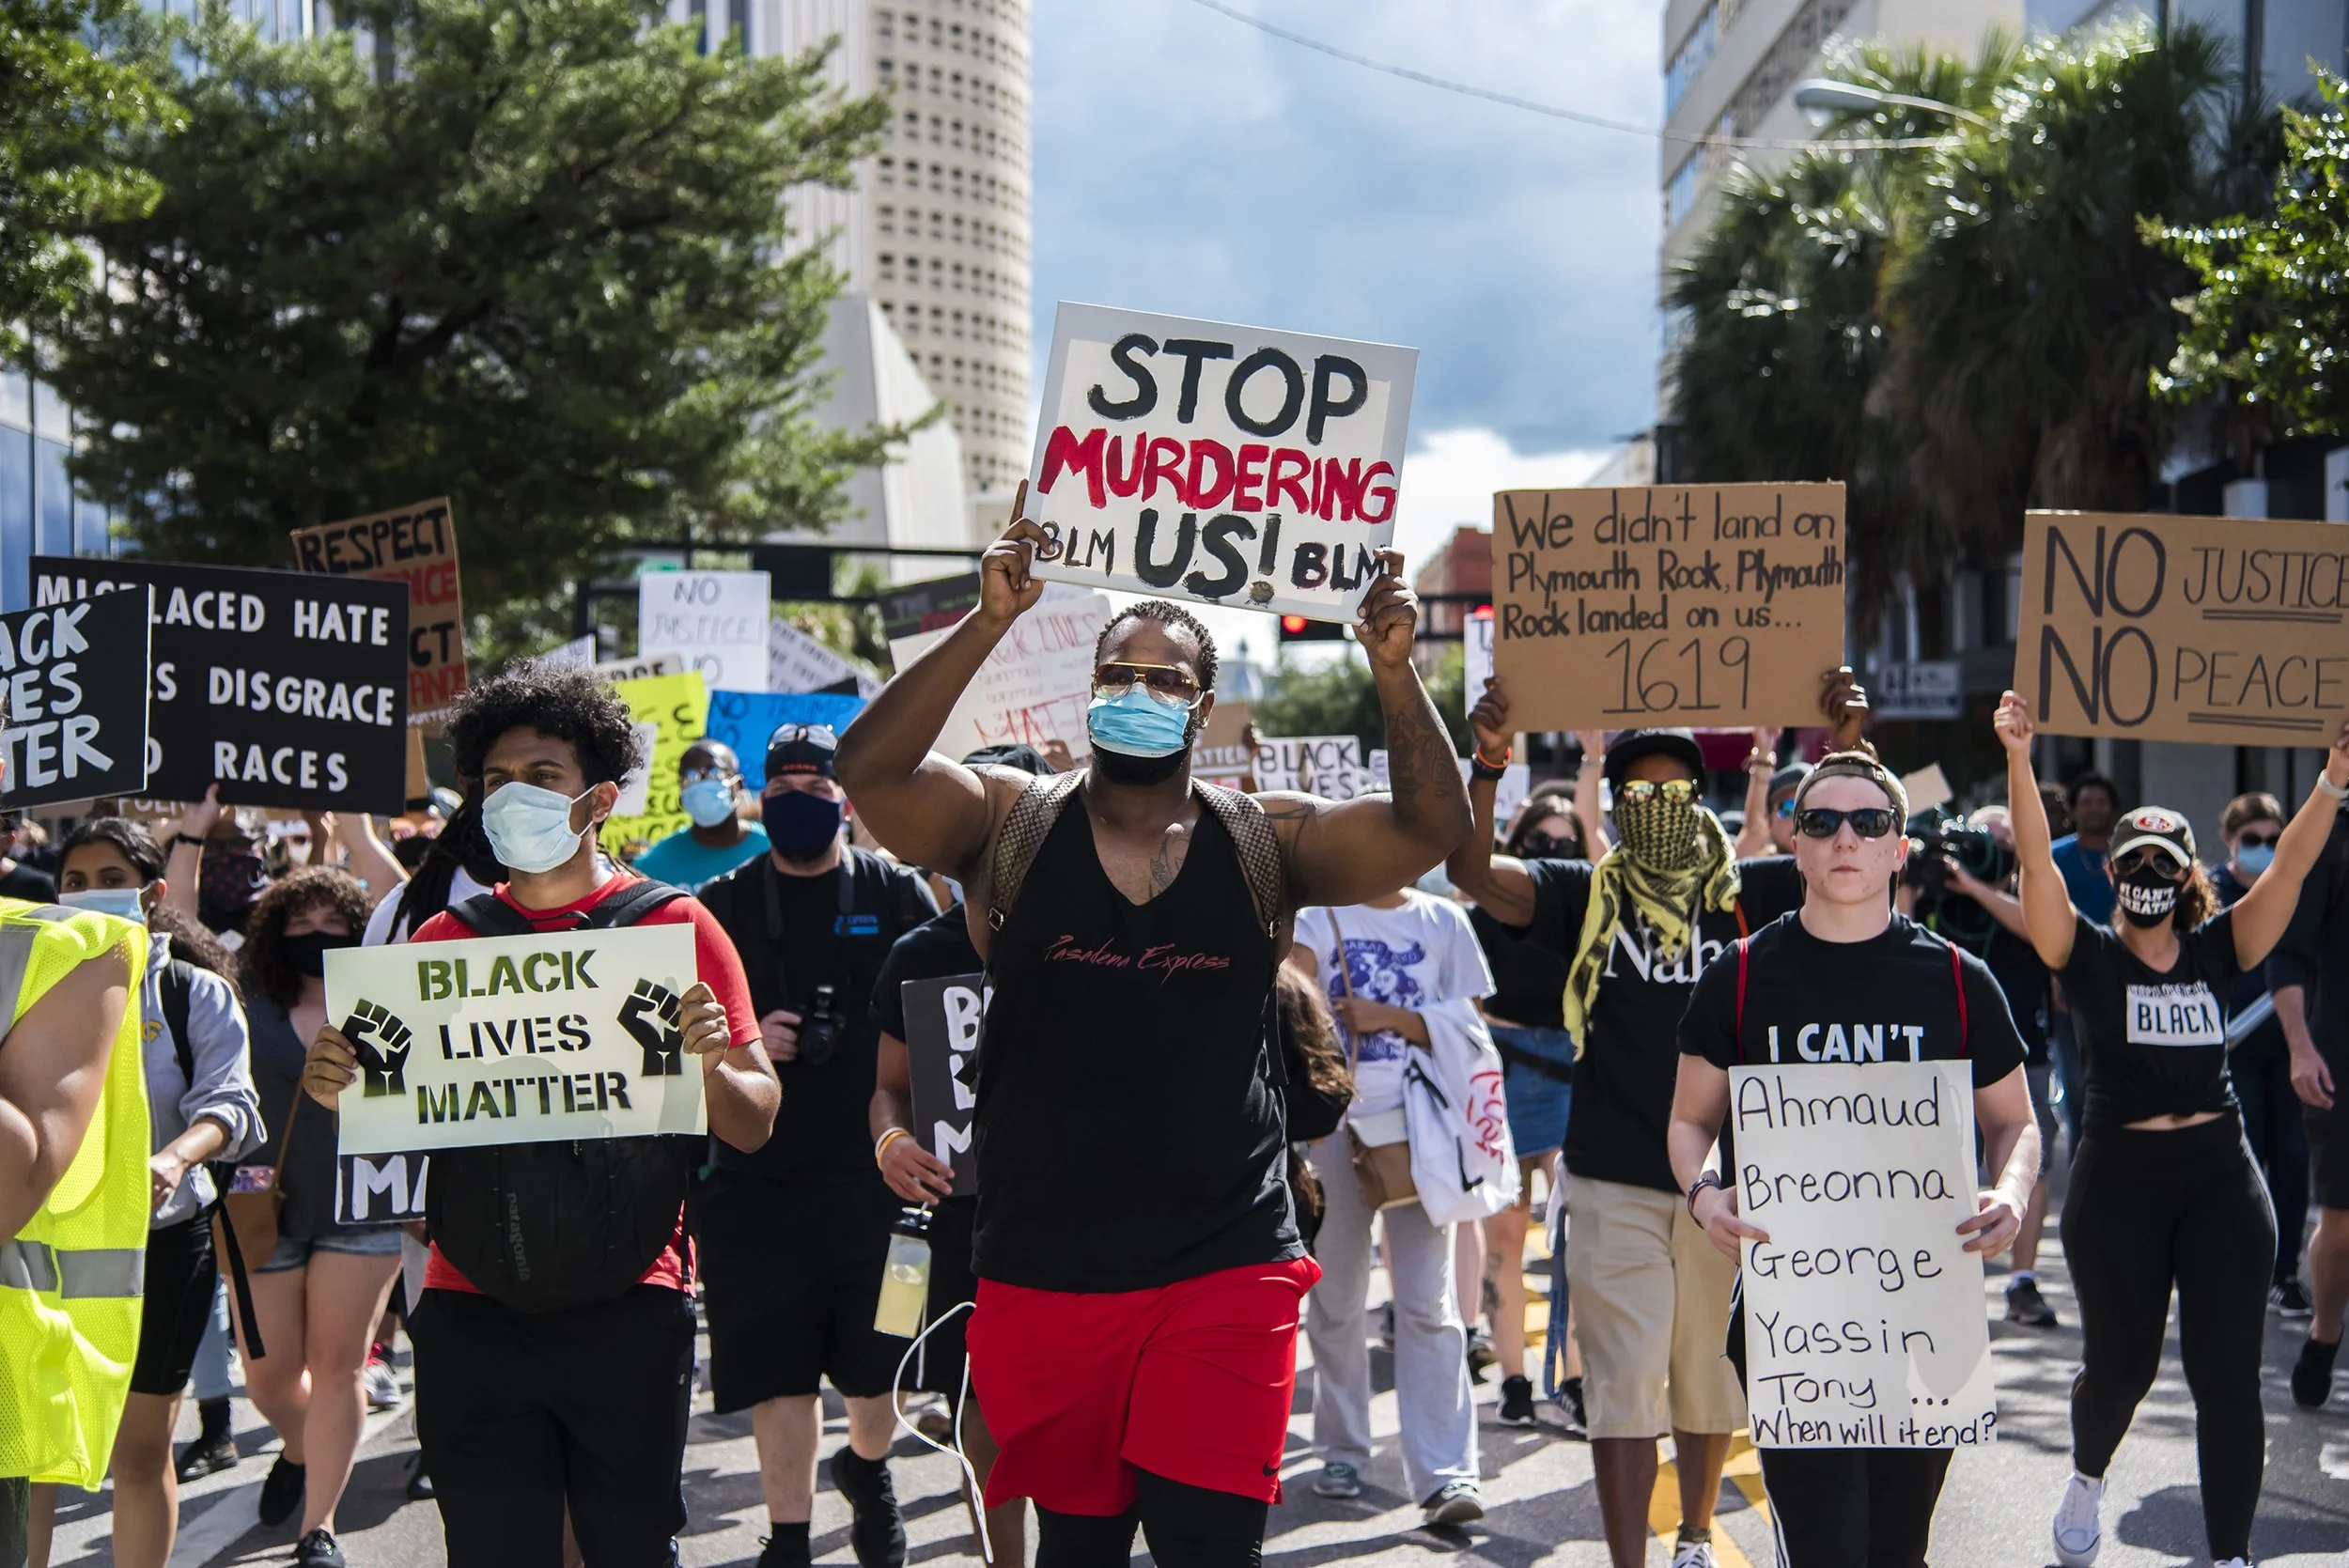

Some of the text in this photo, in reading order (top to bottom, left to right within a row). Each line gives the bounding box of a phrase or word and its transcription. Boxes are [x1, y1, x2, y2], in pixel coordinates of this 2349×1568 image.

[1087, 333, 1368, 445] STOP
[1037, 426, 1397, 524] MURDERING
[298, 506, 447, 573] RESPECT
[1504, 489, 1835, 551] We didn't land on
[1034, 507, 1386, 606] BLM US! BLM
[1507, 545, 1843, 609] Plymouth Rock, Plymouth
[2044, 525, 2349, 618] NO JUSTICE
[37, 574, 390, 645] MIACED HATE
[674, 577, 723, 605] NO
[1503, 593, 1802, 640] Rock landed on us...
[410, 620, 455, 667] CT
[209, 666, 394, 726] DISGRACE
[1602, 636, 1750, 714] 1619
[2038, 623, 2158, 728] NO
[2173, 645, 2346, 711] PEACE
[214, 740, 348, 792] RACES
[1259, 741, 1357, 773] BLACK
[417, 948, 599, 1001] BLACK
[1044, 934, 1231, 985] Pasadena Express
[438, 1014, 592, 1060] LIVES
[1767, 1023, 1924, 1063] I CAN'T
[416, 1071, 632, 1125] MATTER
[1737, 1076, 1941, 1131] Ahmaud
[1743, 1164, 1955, 1211] Breonna
[506, 1190, 532, 1282] patagonia
[1750, 1240, 1943, 1293] George
[1755, 1311, 1936, 1358] Yassin
[1758, 1372, 1877, 1408] Tony
[1752, 1408, 1831, 1445] When
[1841, 1414, 1886, 1445] will
